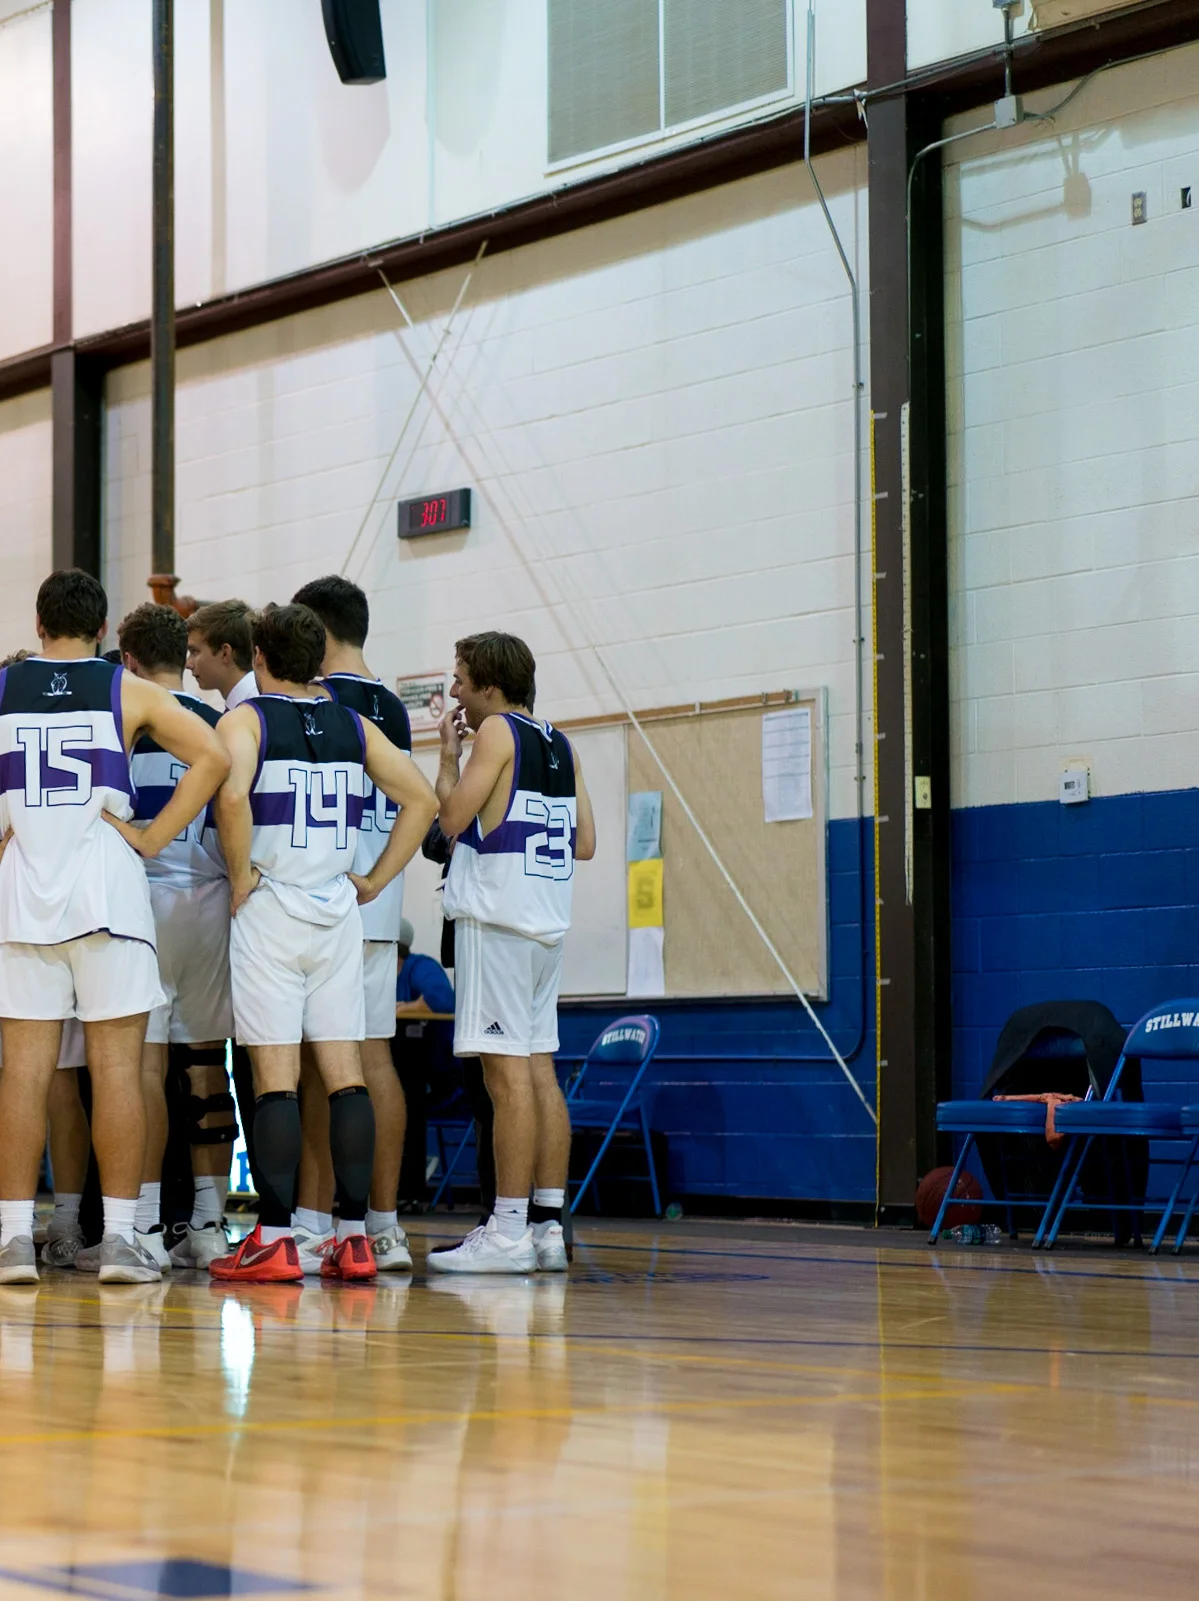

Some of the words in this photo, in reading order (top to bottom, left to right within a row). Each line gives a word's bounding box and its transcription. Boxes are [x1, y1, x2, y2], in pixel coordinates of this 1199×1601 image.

[17, 725, 92, 807] 15
[289, 768, 348, 849] 14
[524, 799, 573, 881] 23
